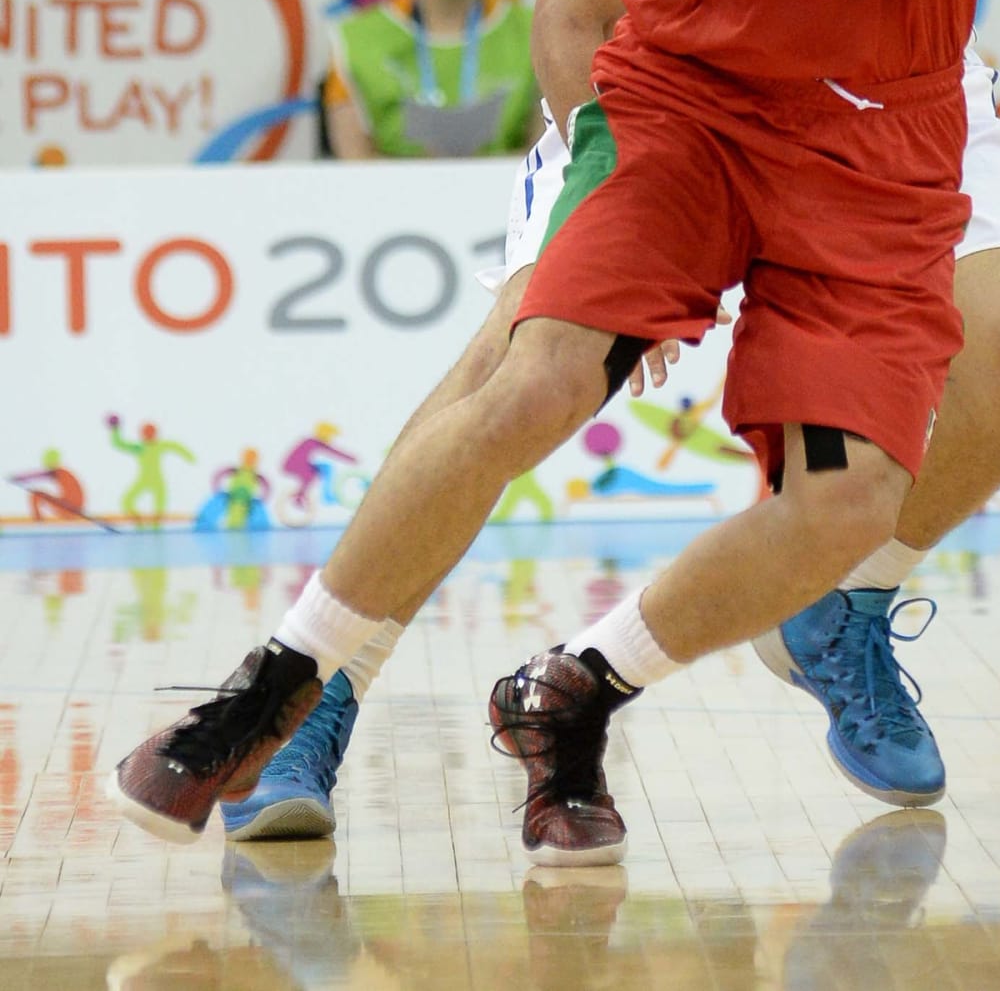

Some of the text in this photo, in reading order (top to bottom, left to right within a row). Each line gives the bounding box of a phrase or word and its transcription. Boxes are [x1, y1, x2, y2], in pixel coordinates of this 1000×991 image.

[23, 73, 214, 136] PLAY!
[0, 234, 506, 336] TO 20
